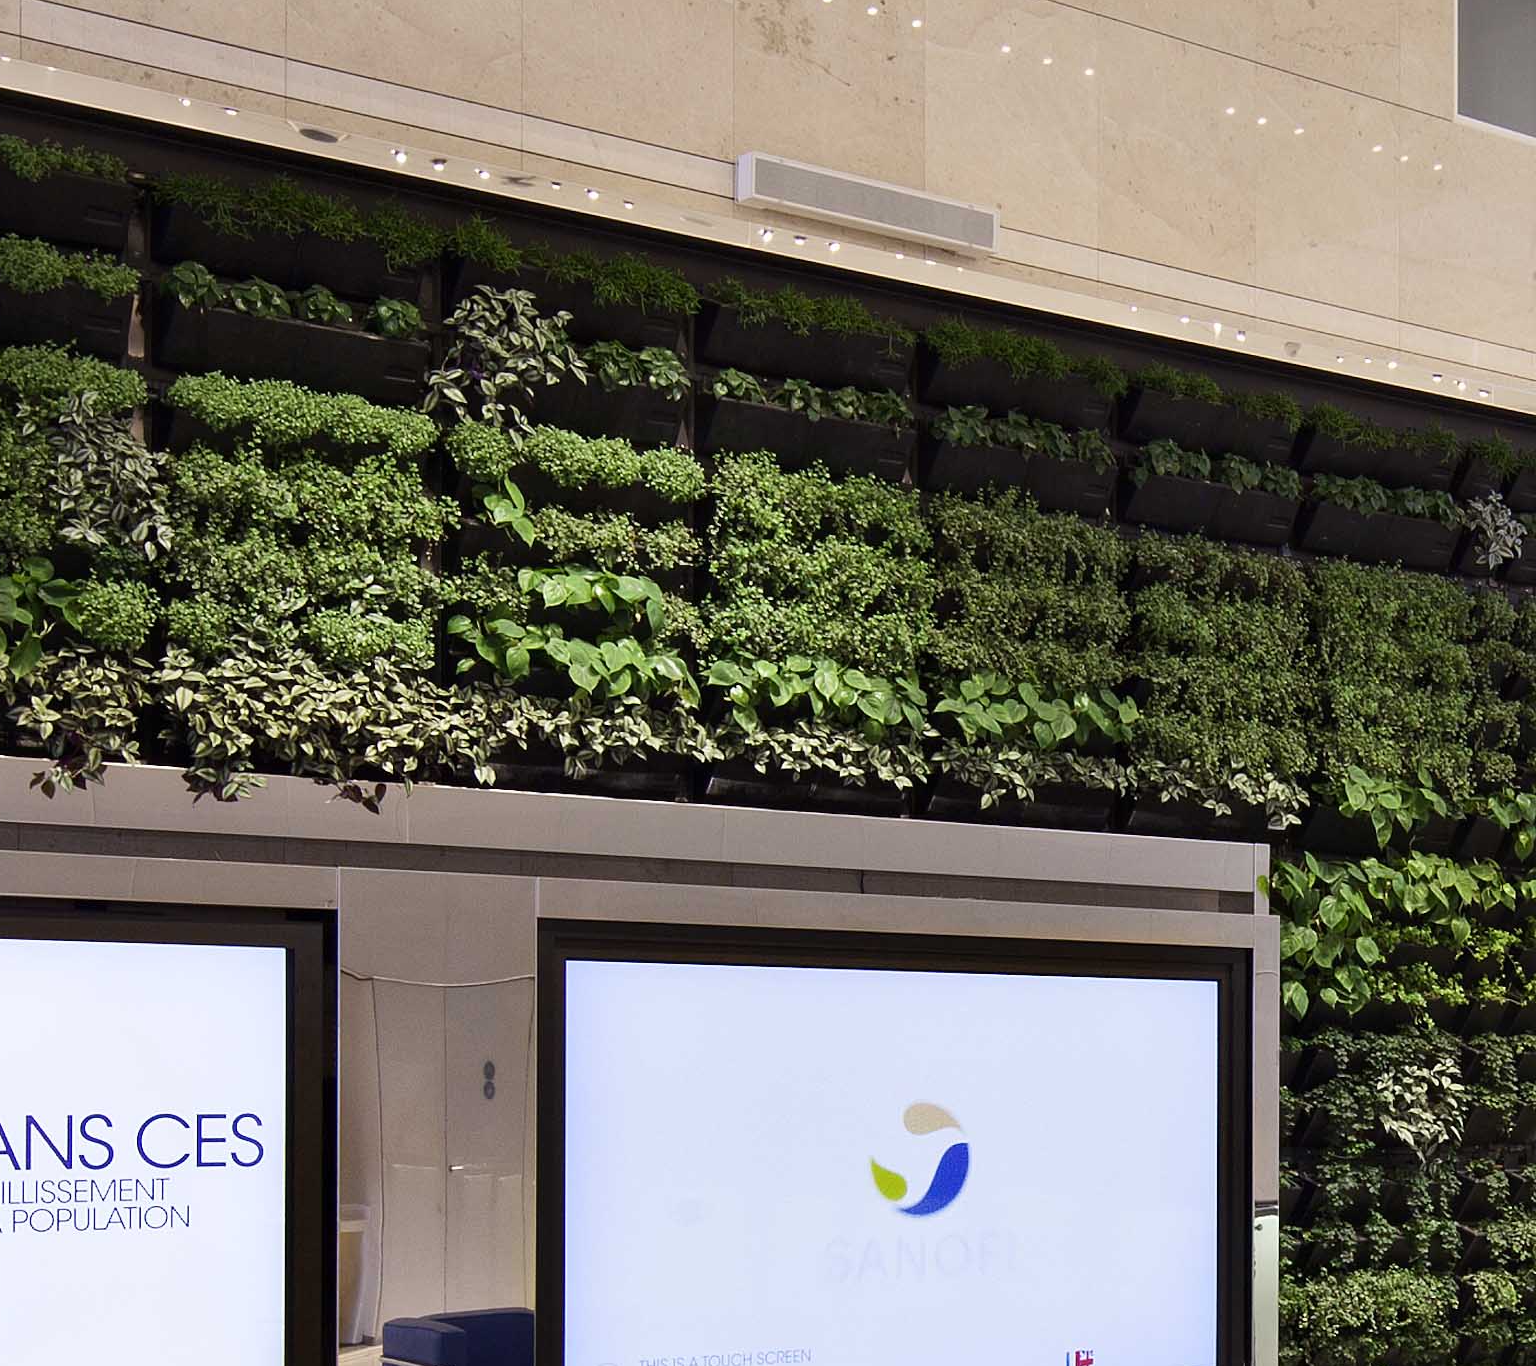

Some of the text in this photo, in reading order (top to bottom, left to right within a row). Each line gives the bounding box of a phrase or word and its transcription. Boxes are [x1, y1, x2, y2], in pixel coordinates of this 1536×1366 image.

[136, 1113, 265, 1169] CES
[12, 1205, 190, 1233] POPULATION
[825, 1228, 1017, 1284] SANOFI
[756, 1348, 812, 1366] SCREEN
